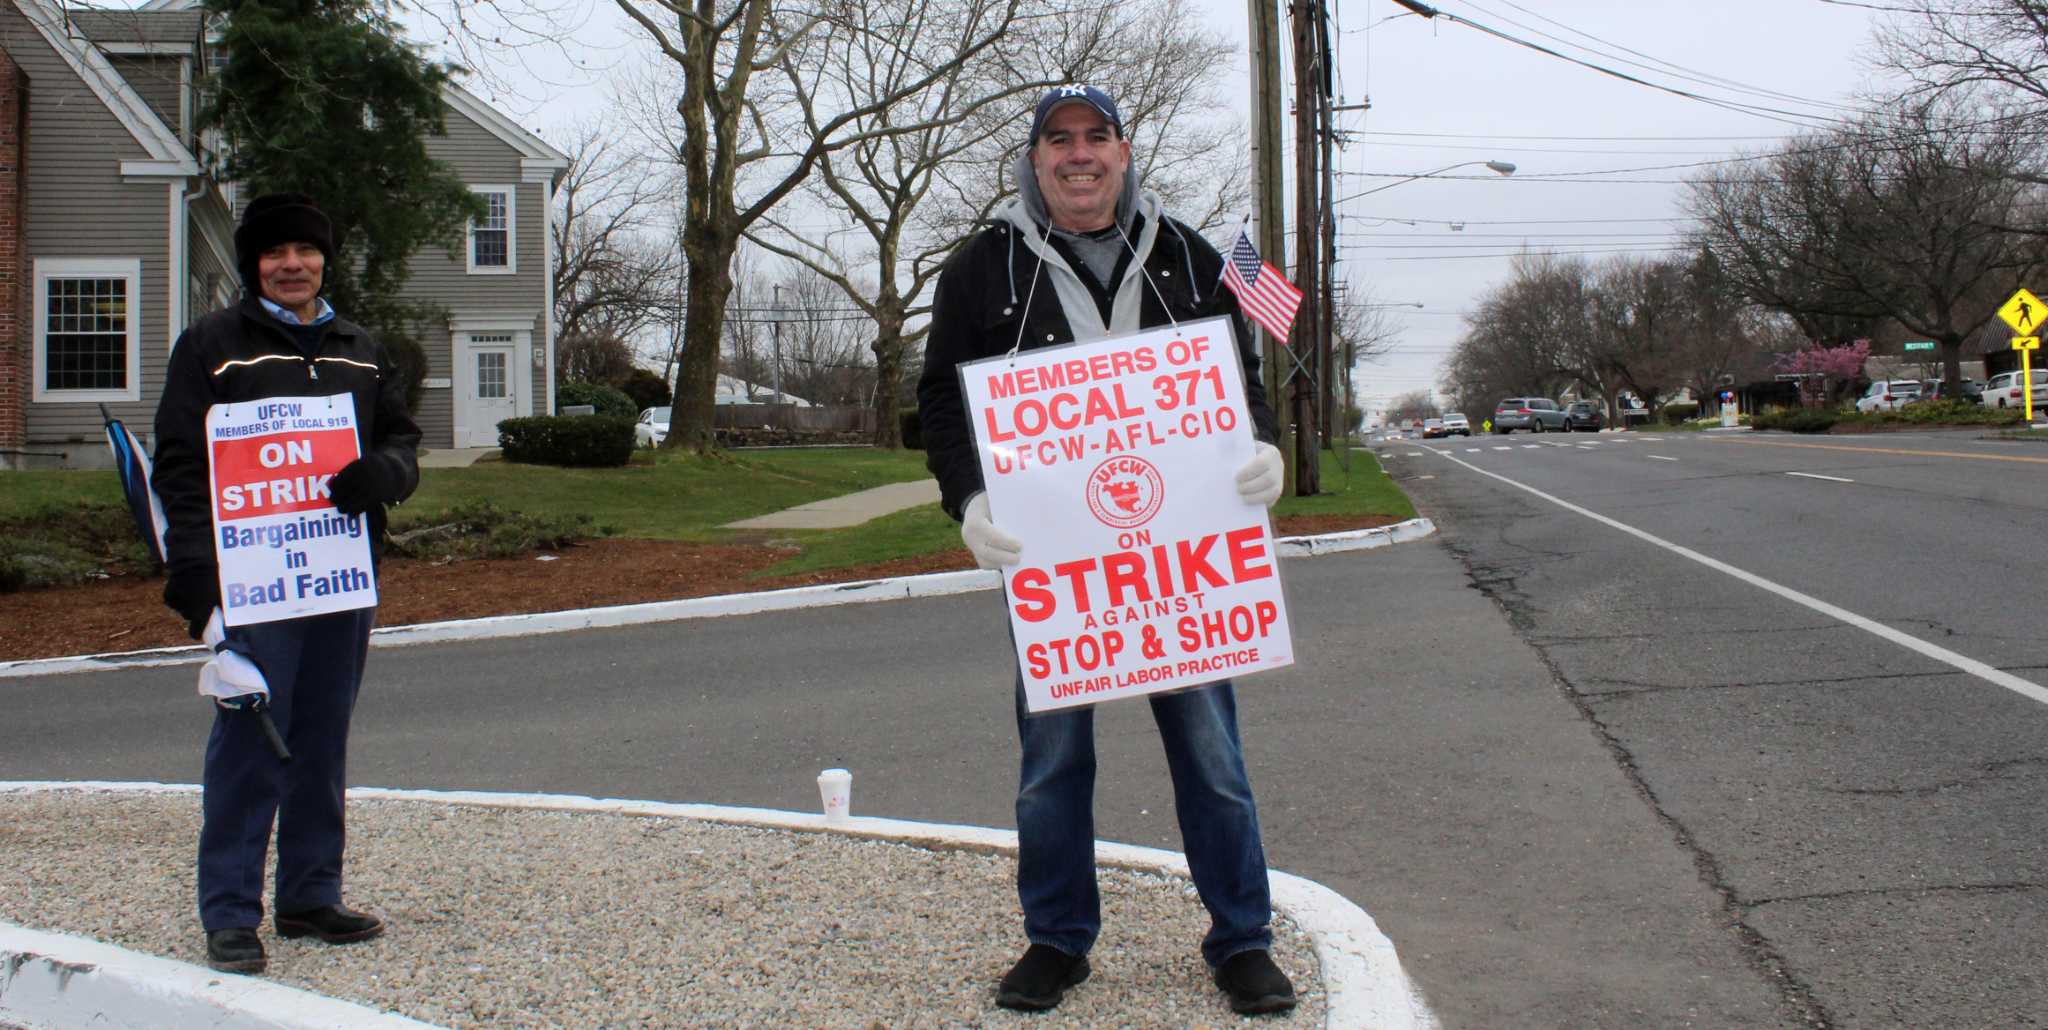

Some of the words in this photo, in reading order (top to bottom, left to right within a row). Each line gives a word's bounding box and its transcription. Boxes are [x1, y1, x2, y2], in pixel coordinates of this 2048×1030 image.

[987, 346, 1158, 400] MEMBERS
[1165, 336, 1210, 367] OF
[258, 403, 302, 420] UFCW
[983, 382, 1145, 444] LOCAL
[1152, 365, 1226, 411] 371
[215, 419, 269, 438] MEMBERS
[272, 418, 287, 431] OF
[292, 416, 325, 429] LOCAL
[327, 416, 348, 428] 919
[992, 406, 1237, 475] UFCW-AFL-CIO
[259, 439, 313, 468] ON
[1096, 460, 1147, 483] UFCW
[222, 472, 338, 511] STRIK
[221, 513, 362, 550] Bargaining
[1118, 529, 1151, 550] ON
[286, 548, 308, 569] in
[1010, 525, 1273, 623] STRIKE
[227, 577, 286, 608] Bad
[296, 567, 369, 599] Faith
[1084, 593, 1206, 630] AGAINST
[1026, 630, 1124, 680] STOP
[1141, 624, 1167, 660] &
[1176, 600, 1278, 653] SHOP
[1050, 675, 1112, 699] UNFAIR
[1116, 665, 1173, 688] LABOR
[1177, 648, 1260, 677] PRACTICE
